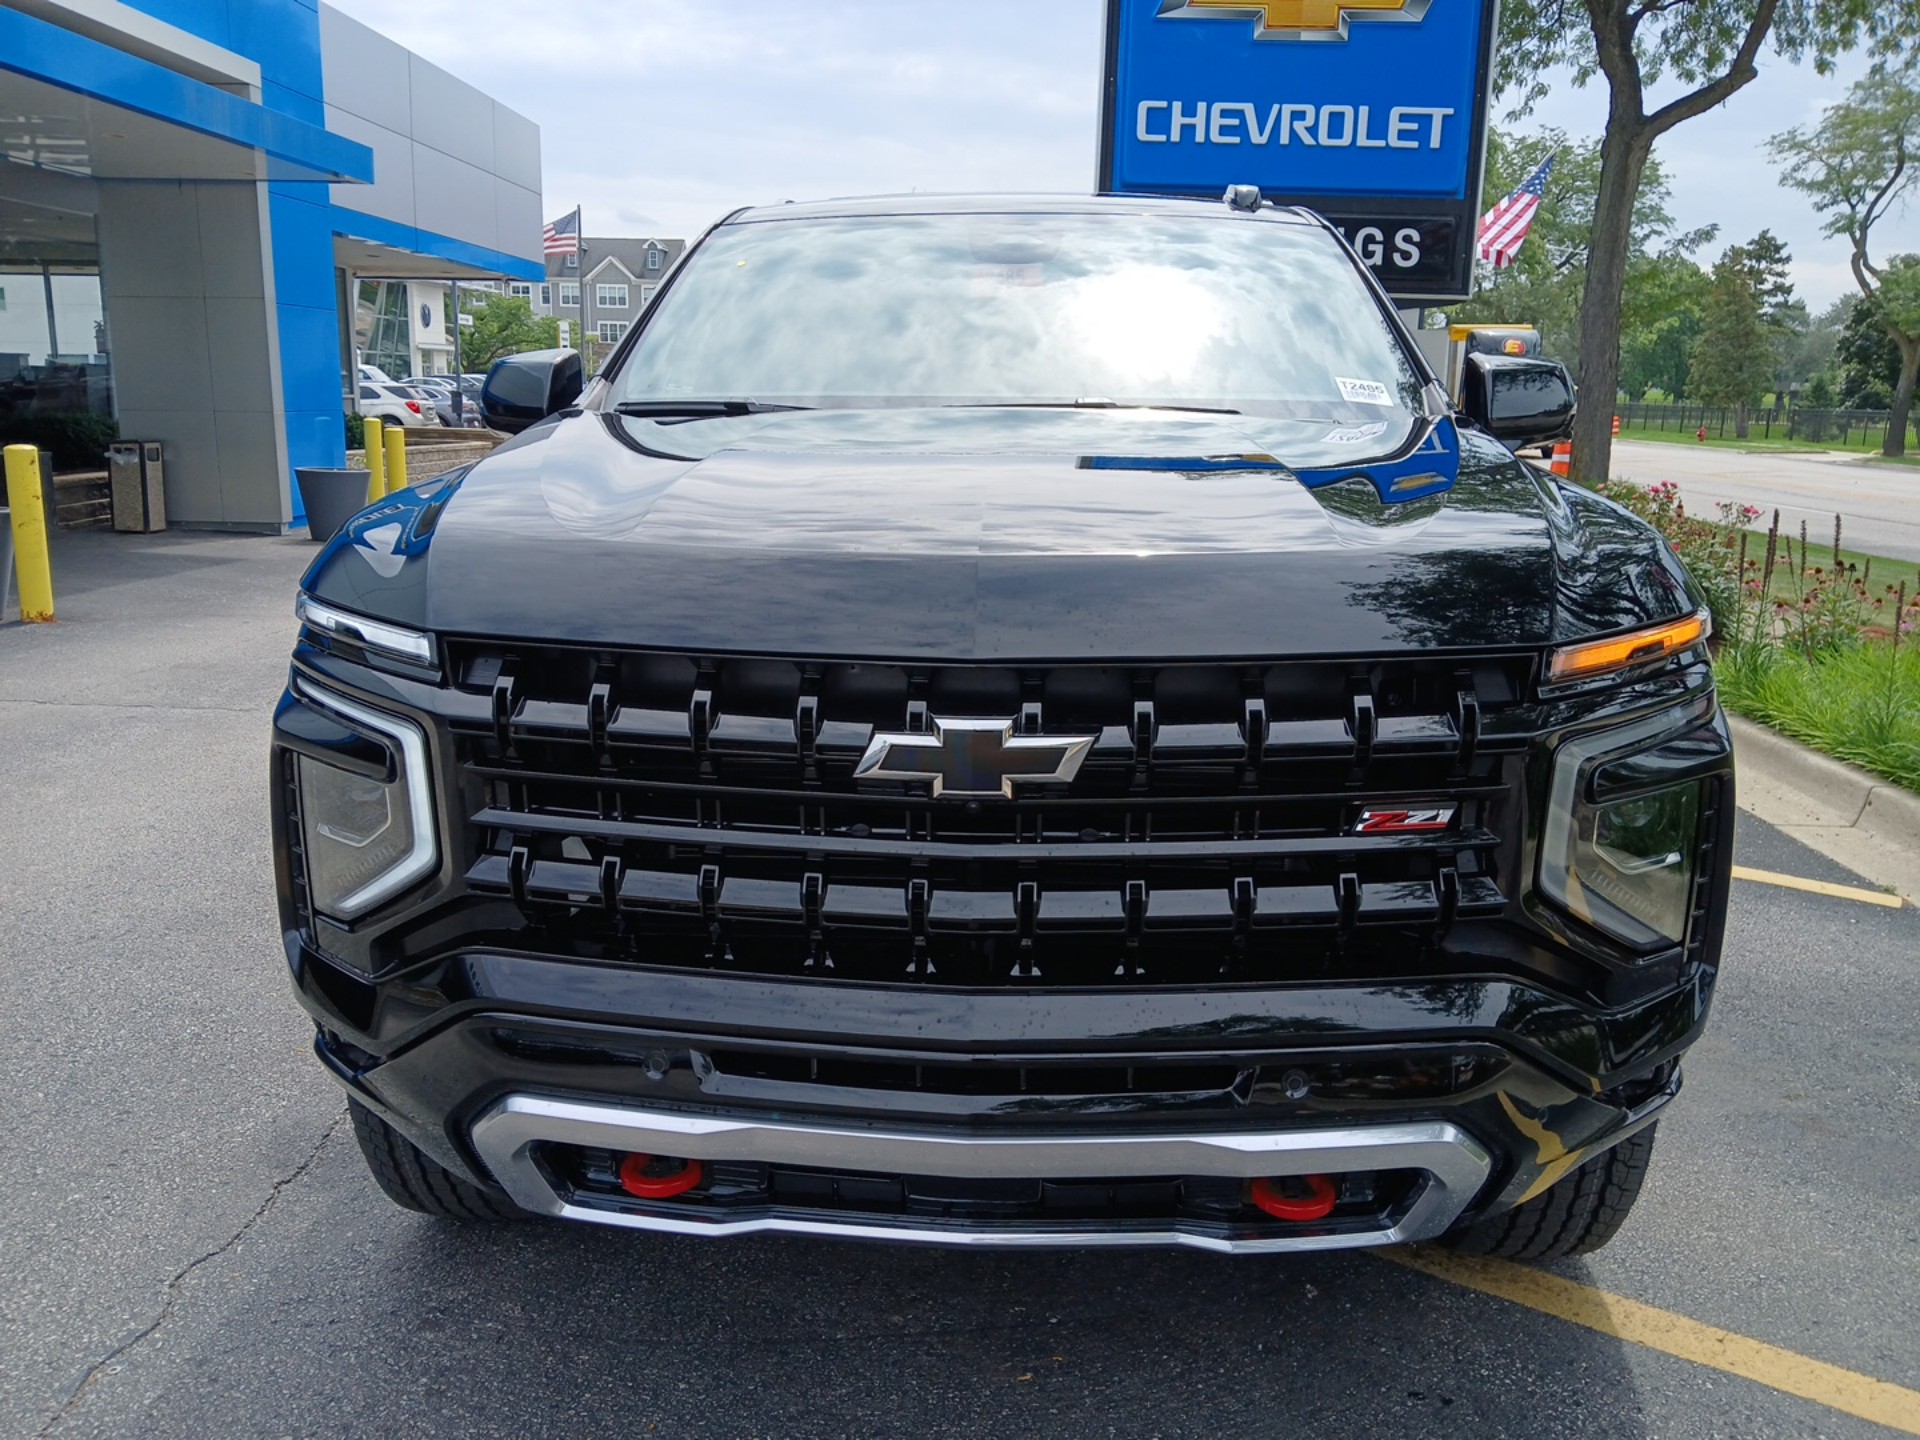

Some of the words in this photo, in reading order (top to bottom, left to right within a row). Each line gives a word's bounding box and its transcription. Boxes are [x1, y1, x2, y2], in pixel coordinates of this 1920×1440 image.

[1136, 100, 1454, 149] CHEVROLET
[1344, 226, 1421, 268] GS
[1355, 808, 1454, 832] Z71
